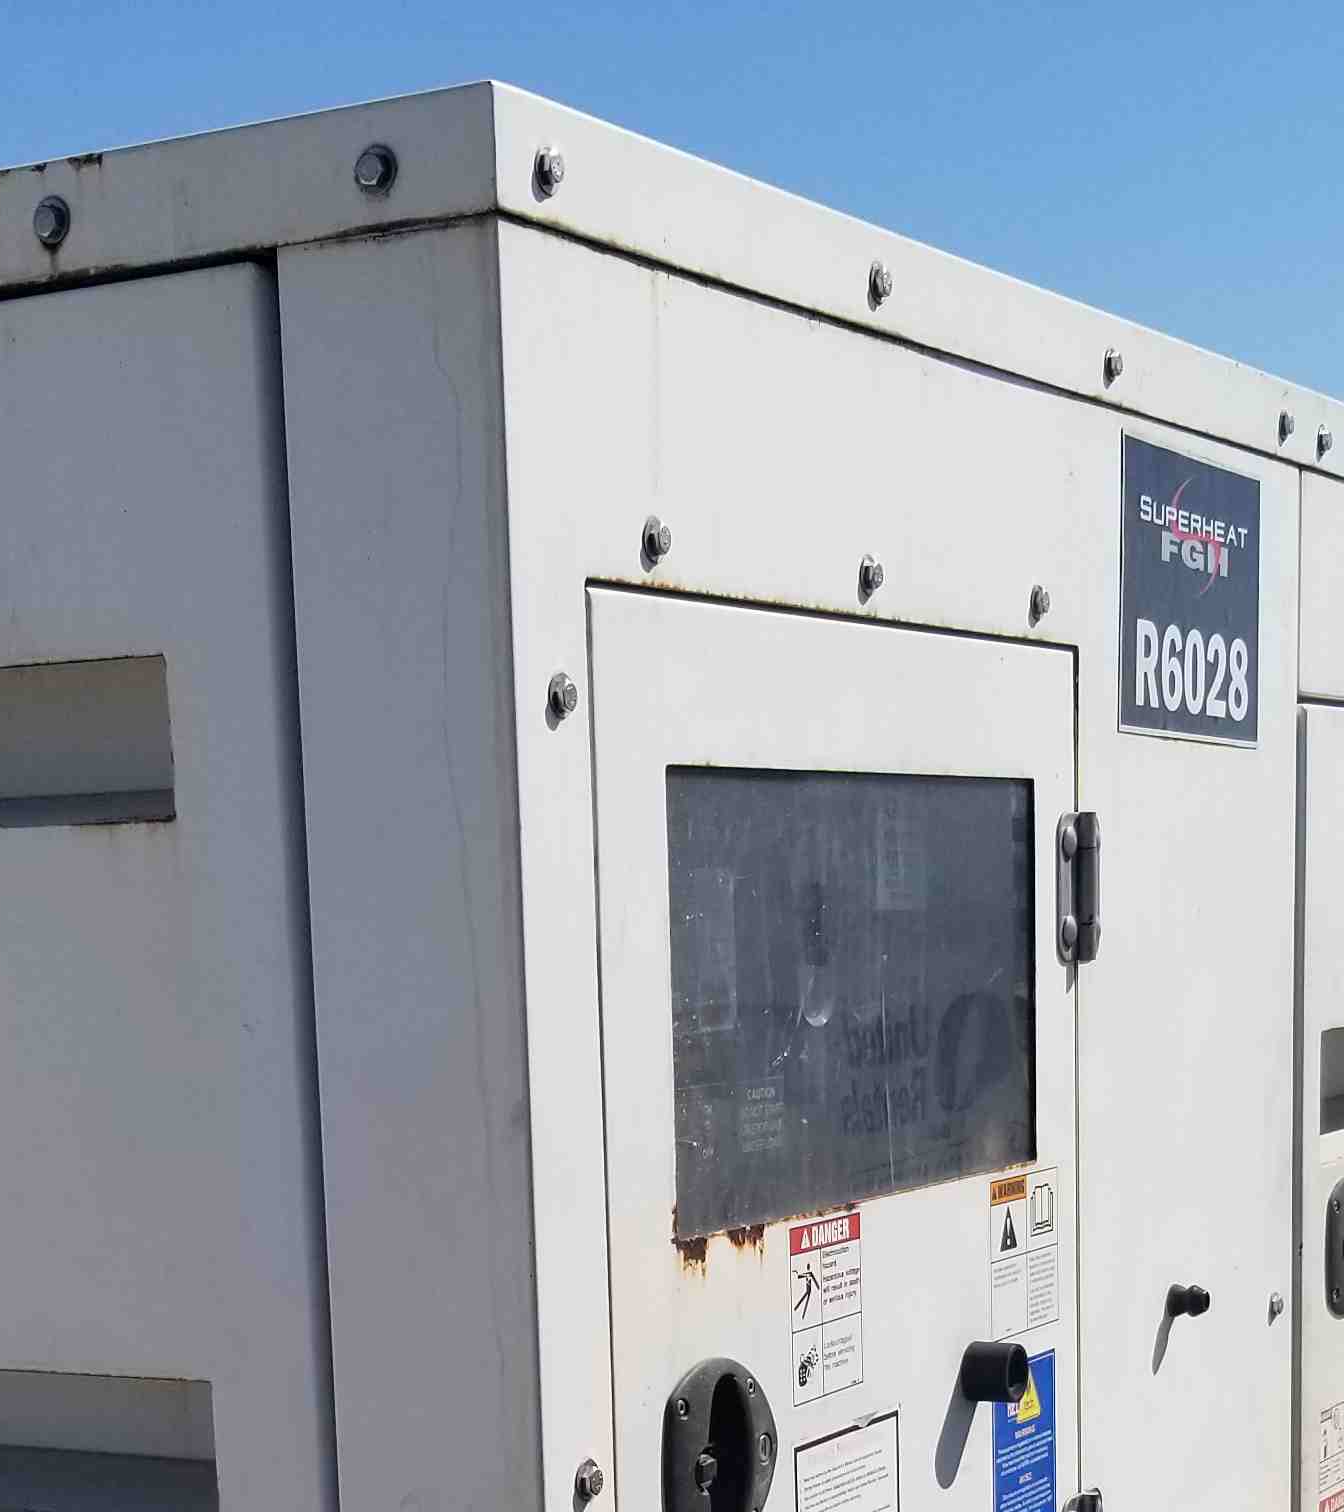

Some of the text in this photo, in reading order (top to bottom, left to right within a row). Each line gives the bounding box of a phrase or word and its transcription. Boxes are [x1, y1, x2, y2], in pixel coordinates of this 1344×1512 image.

[1139, 494, 1248, 549] SUPERHEAT
[1135, 617, 1249, 723] R6028
[811, 1217, 850, 1247] DANGER
